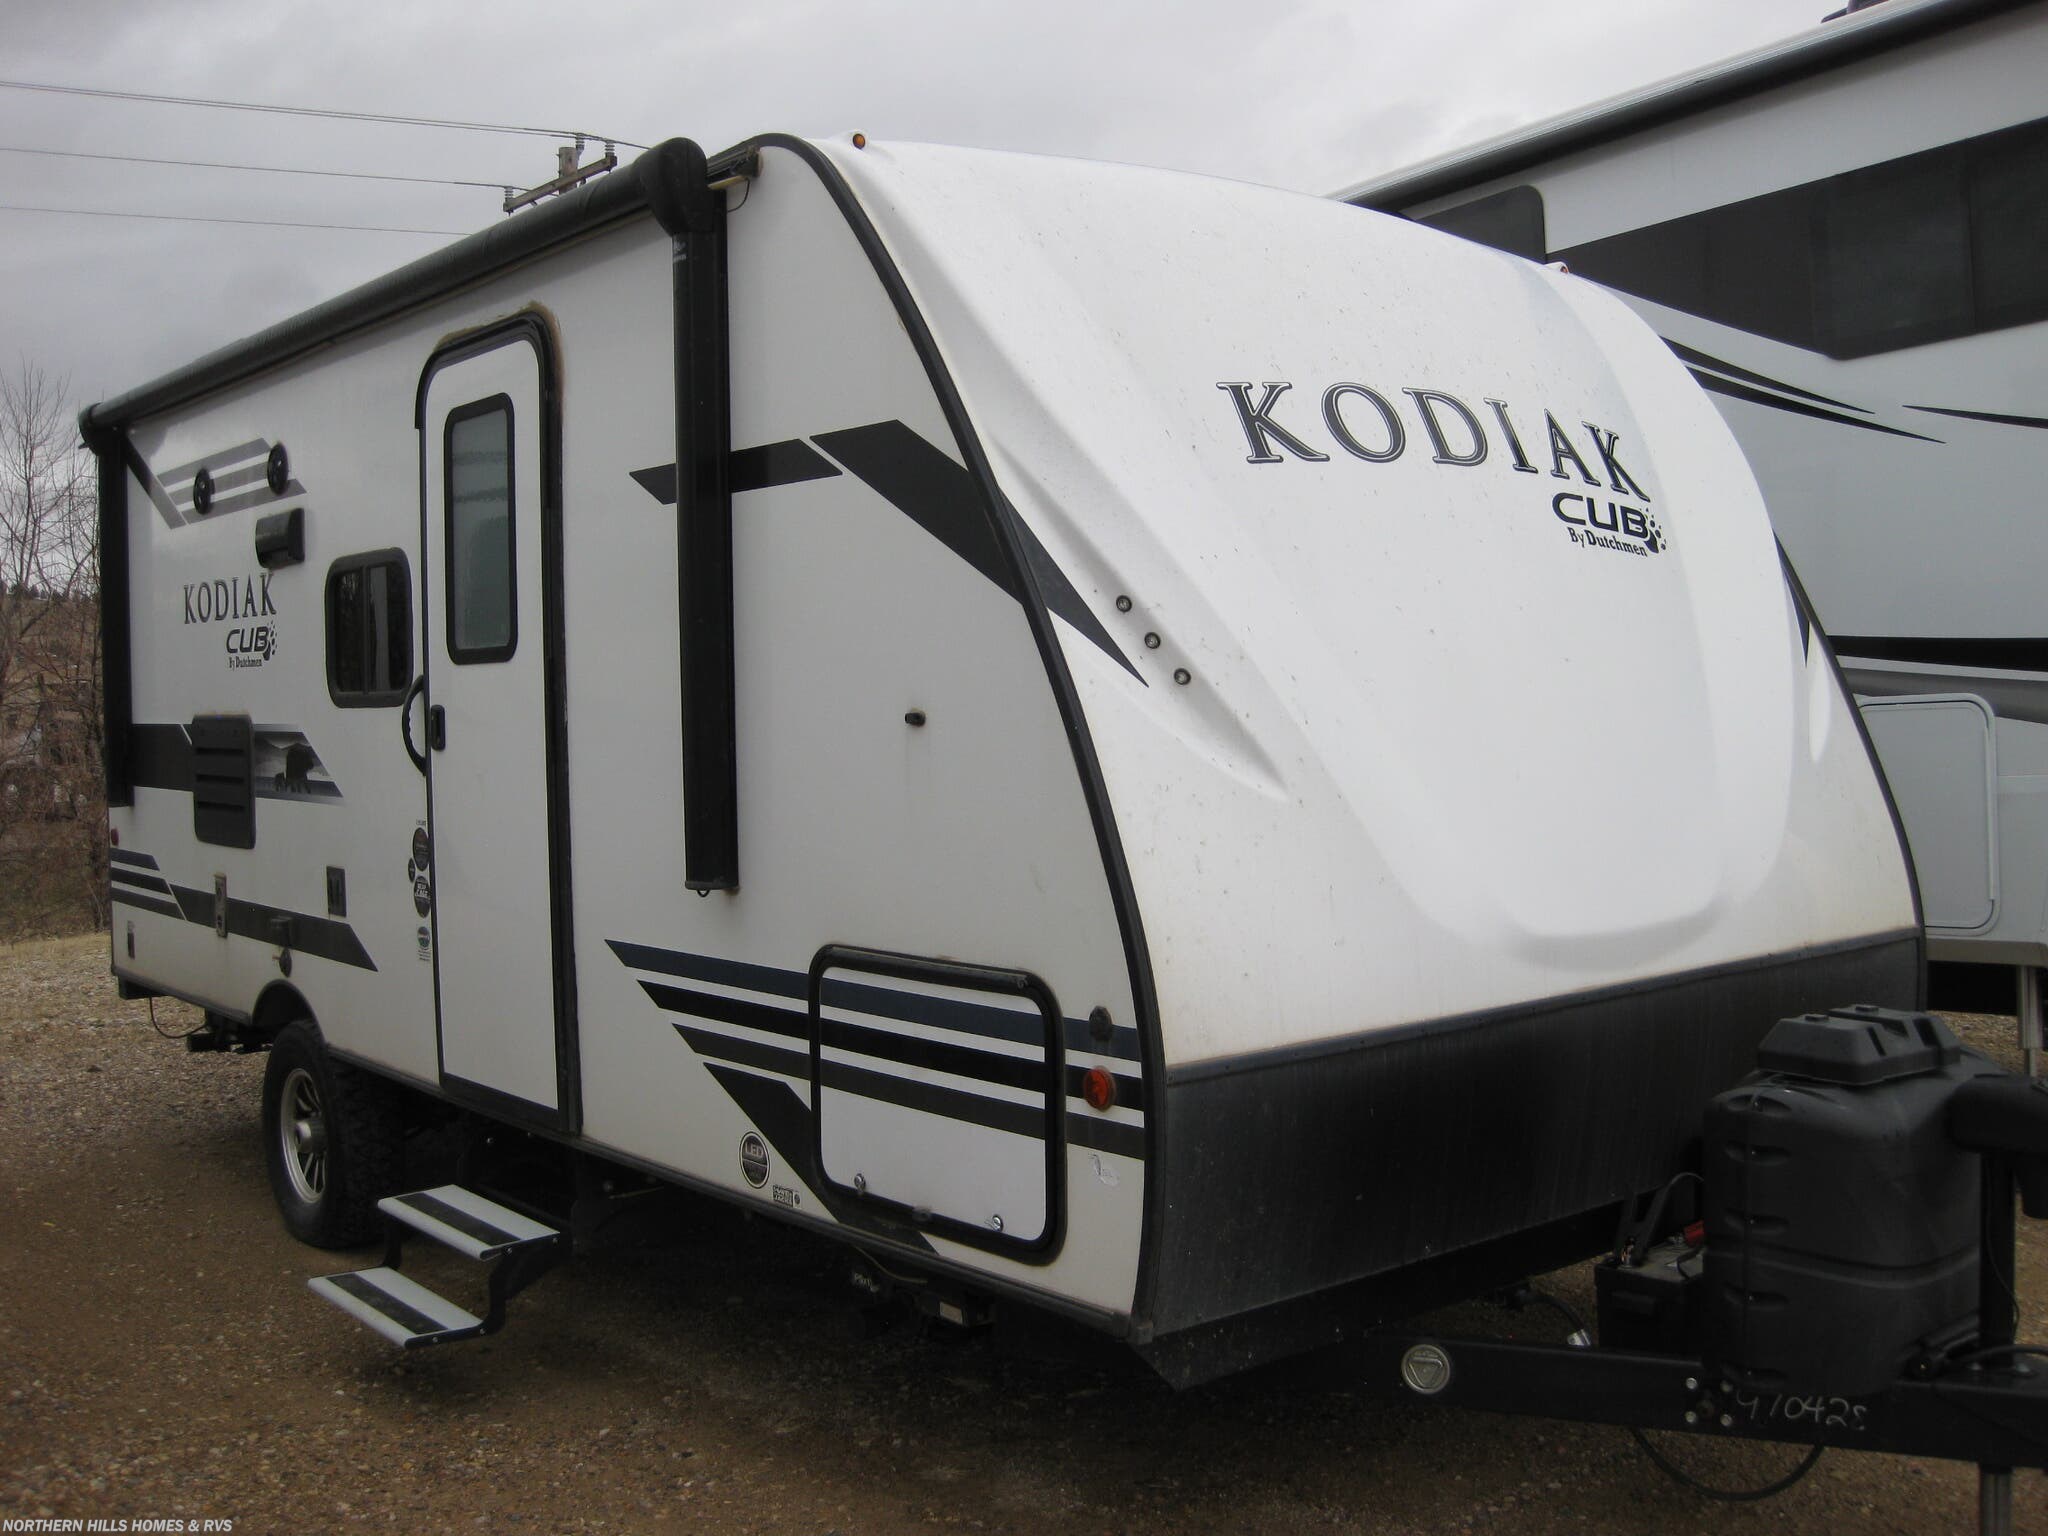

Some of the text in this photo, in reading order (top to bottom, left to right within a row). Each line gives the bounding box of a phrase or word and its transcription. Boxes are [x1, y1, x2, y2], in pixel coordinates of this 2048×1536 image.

[1216, 381, 1651, 503] KODIAK
[1552, 492, 1649, 539] CUB
[1567, 526, 1648, 557] By Dutchmen
[183, 571, 277, 625] KODIAK
[226, 626, 269, 654] CUB
